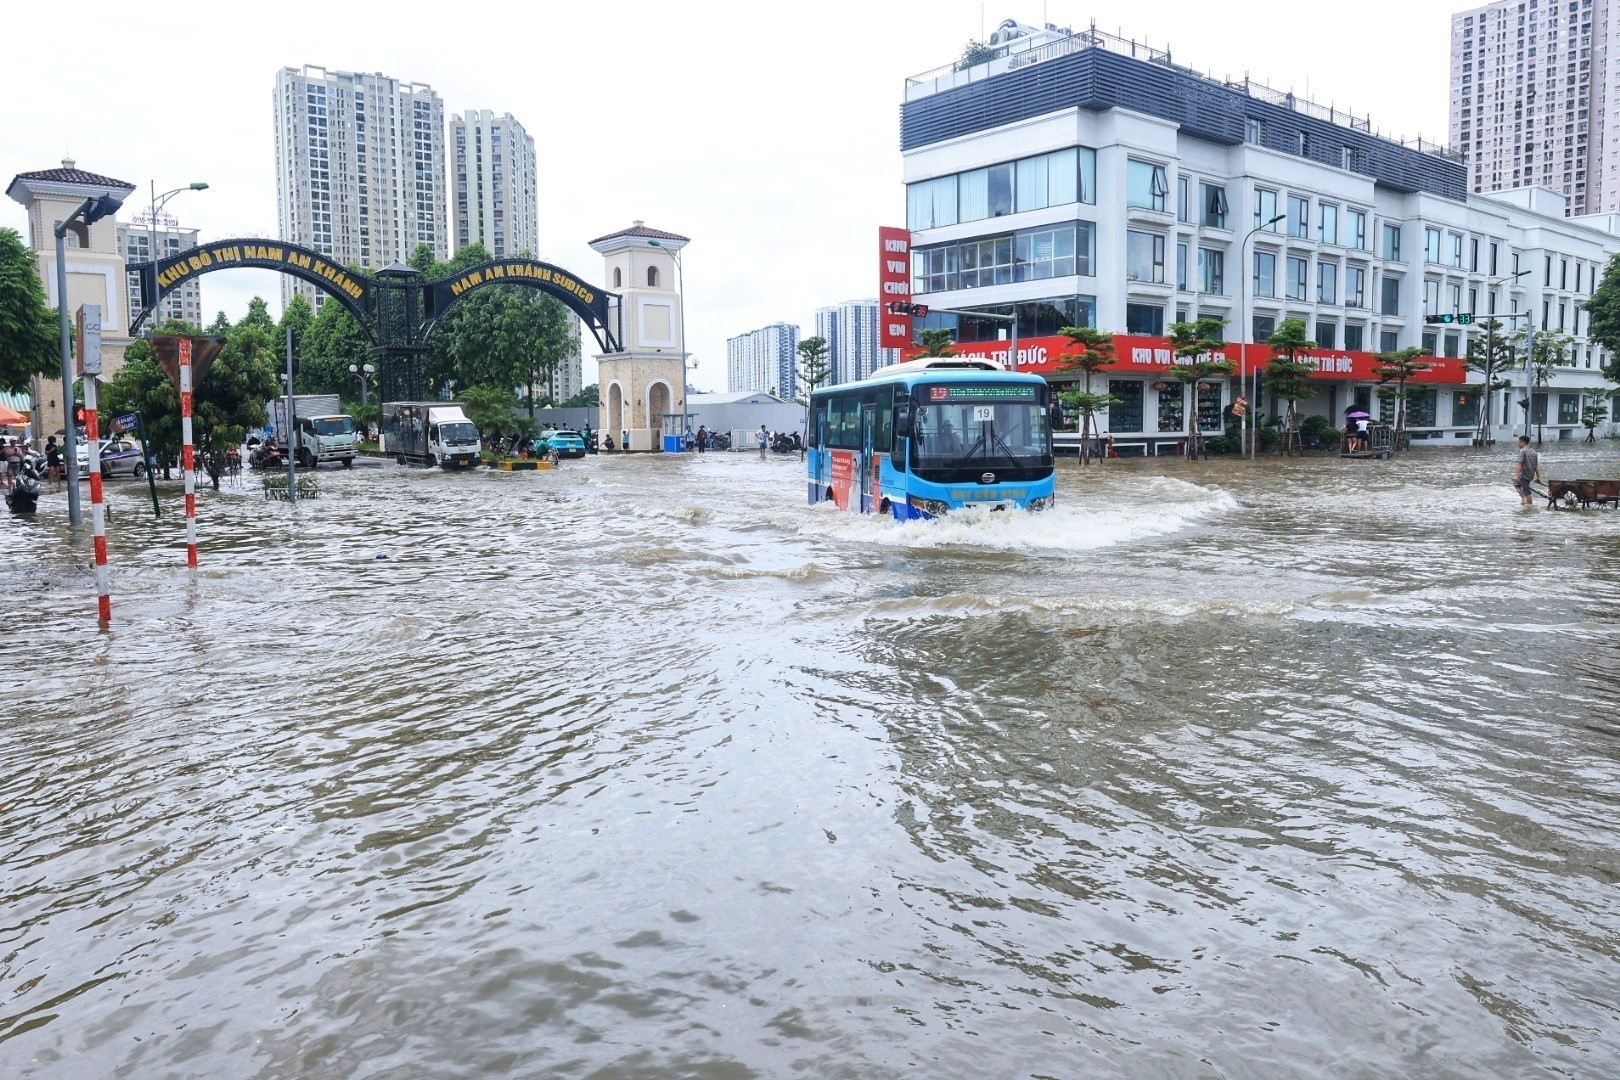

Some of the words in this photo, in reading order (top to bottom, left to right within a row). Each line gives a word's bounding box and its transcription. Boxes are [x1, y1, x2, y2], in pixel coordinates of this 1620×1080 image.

[885, 239, 907, 253] KHU
[157, 261, 189, 288] KHU
[188, 250, 213, 271] ĐÔ
[212, 246, 242, 262] THỊ
[244, 246, 283, 262] NAM
[287, 250, 311, 269] AN
[312, 260, 364, 300] KHÁNH
[886, 260, 906, 274] VUI
[450, 271, 483, 296] NAM
[485, 265, 504, 280] AN
[506, 263, 552, 281] KHÁNH
[552, 273, 594, 304] SUDICO
[1459, 314, 1470, 324] 33
[888, 324, 906, 337] EM
[1017, 345, 1047, 365] ĐỨC
[1131, 347, 1152, 364] KHU
[1154, 348, 1170, 365] VUI
[1321, 354, 1335, 372] TRÍ
[1336, 355, 1353, 373] ĐỨC
[930, 387, 947, 399] 19
[977, 408, 990, 419] 19
